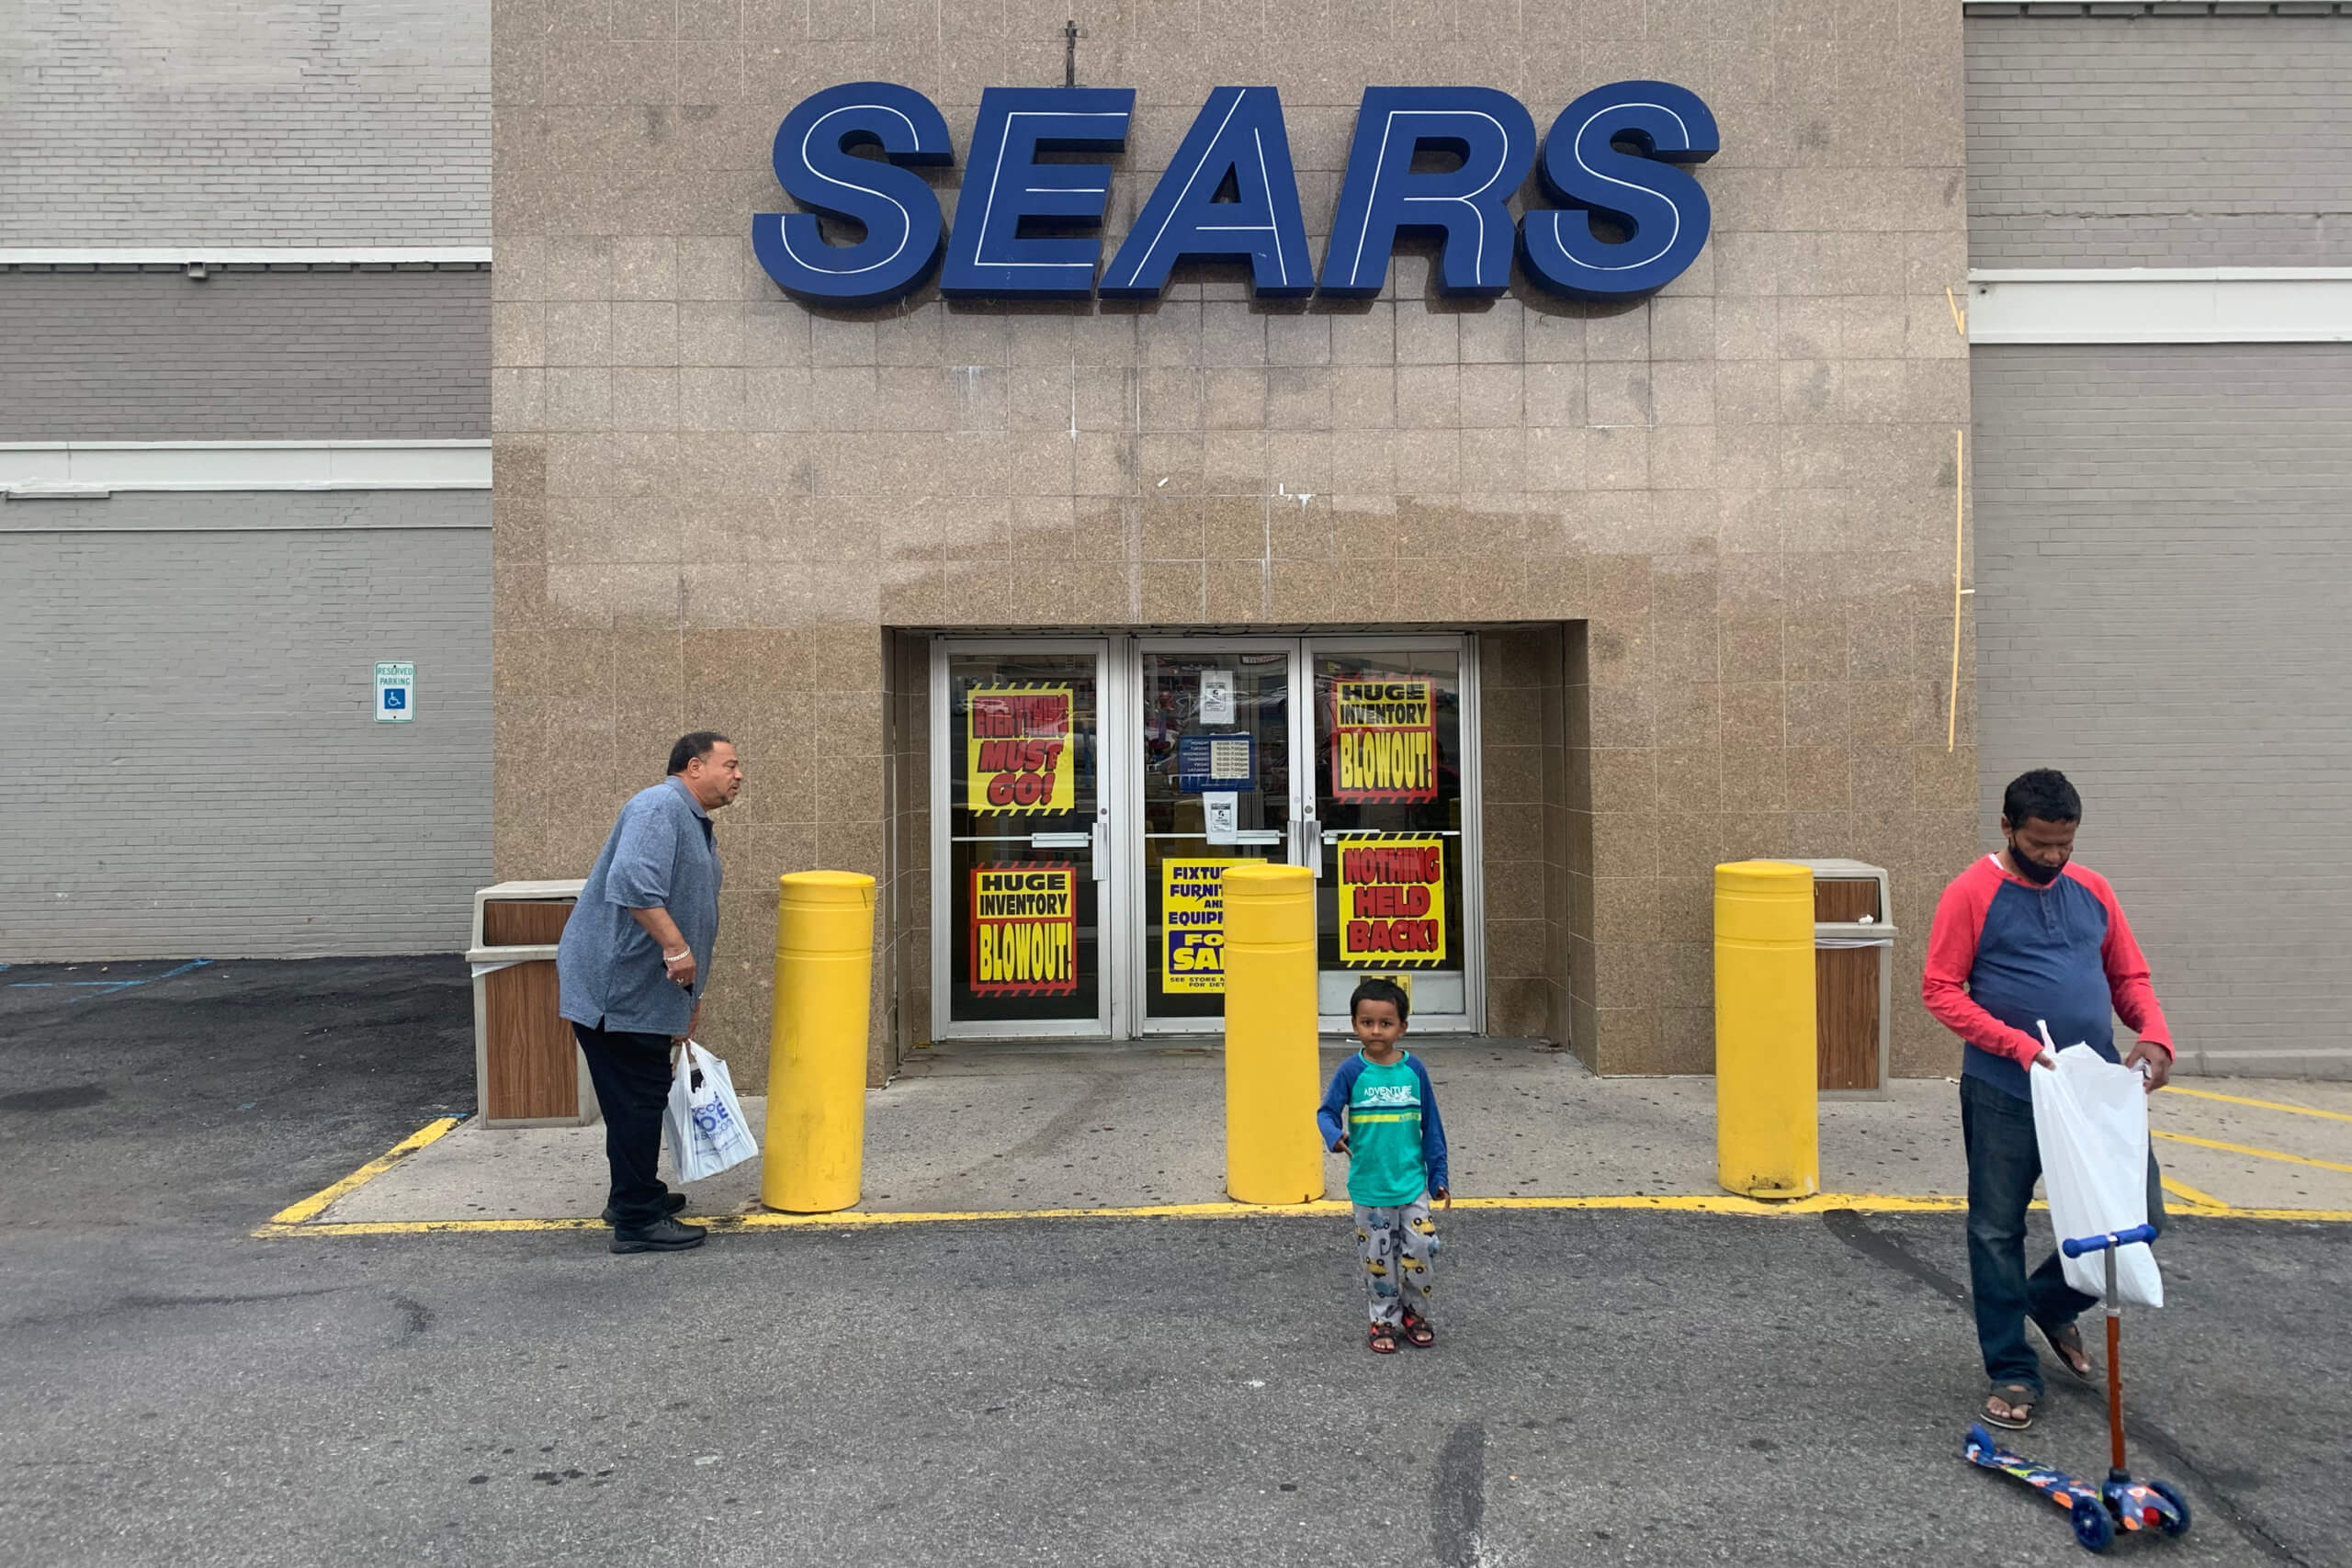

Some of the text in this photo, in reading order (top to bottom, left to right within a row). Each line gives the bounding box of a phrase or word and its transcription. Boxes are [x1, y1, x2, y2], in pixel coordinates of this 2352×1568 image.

[752, 80, 1719, 301] SEARS
[1342, 684, 1425, 701] HUGE
[973, 694, 1069, 739] EVERYTHING
[1340, 704, 1427, 725] INVENTORY
[978, 739, 1064, 773] MUST
[1338, 731, 1432, 792] BLOWOUT!
[987, 772, 1056, 807] GO!
[1173, 867, 1229, 879] FIXTU
[1343, 846, 1441, 885] NOTHING
[981, 874, 1066, 891] HUGE
[1170, 884, 1223, 897] FURNI
[979, 893, 1068, 916] INVENTORY
[1353, 886, 1431, 918] HELD
[1169, 911, 1223, 926] EQUIP
[1184, 933, 1224, 946] FO
[1347, 919, 1439, 953] BACK!
[978, 921, 1072, 983] BLOWOUT!
[1363, 1085, 1412, 1096] ADVENTURE
